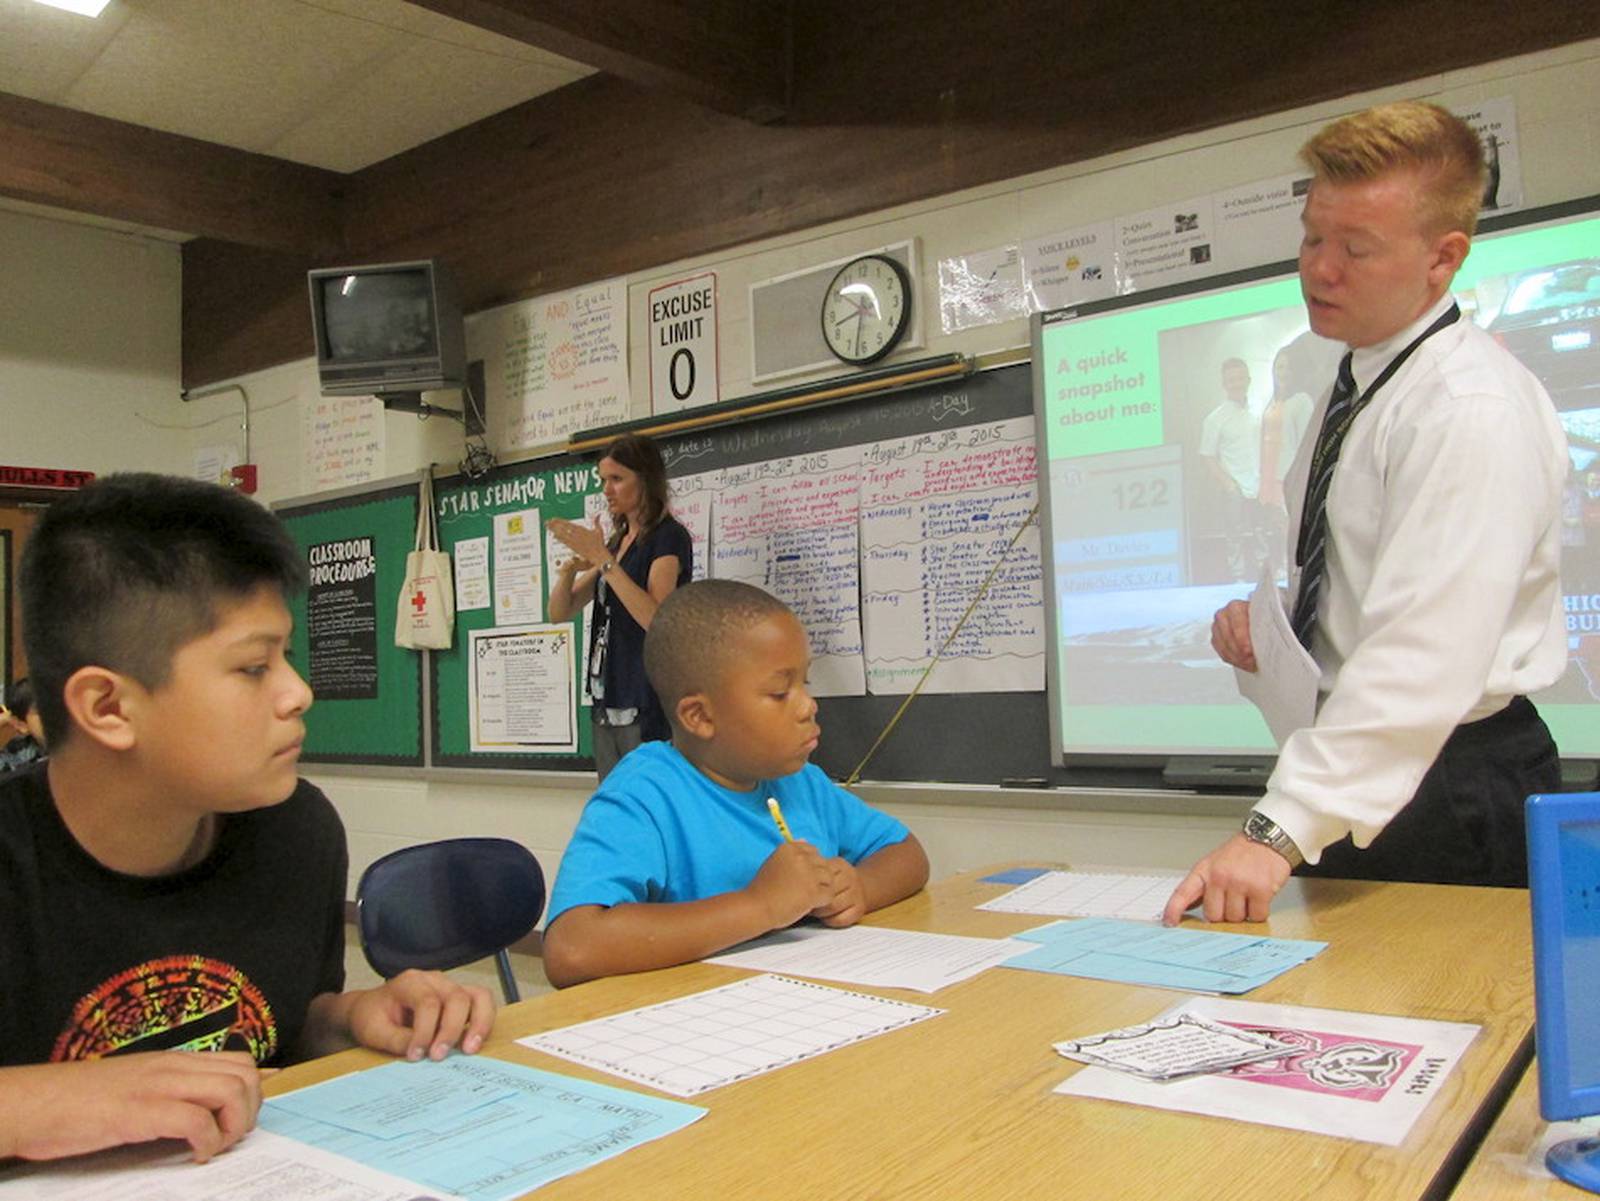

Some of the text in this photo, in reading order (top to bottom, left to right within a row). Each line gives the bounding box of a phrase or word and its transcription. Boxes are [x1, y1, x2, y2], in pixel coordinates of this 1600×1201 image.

[575, 287, 614, 314] Equal
[652, 288, 712, 323] EXCUSE
[660, 317, 704, 347] LIMIT
[1057, 346, 1128, 375] A quick
[1058, 371, 1146, 401] snapshot
[1060, 401, 1157, 426] about me:
[722, 427, 813, 453] Wednesday
[870, 425, 1005, 466] August 2015
[677, 477, 704, 493] 2015
[719, 468, 751, 490] August
[799, 454, 829, 474] 2015
[868, 468, 906, 490] Targets
[439, 465, 602, 517] STAR SENATOR NEWS
[719, 492, 749, 510] Targets
[1112, 478, 1170, 512] 122
[309, 538, 372, 566] CLASSROOM
[309, 556, 377, 587] PROCEDURES
